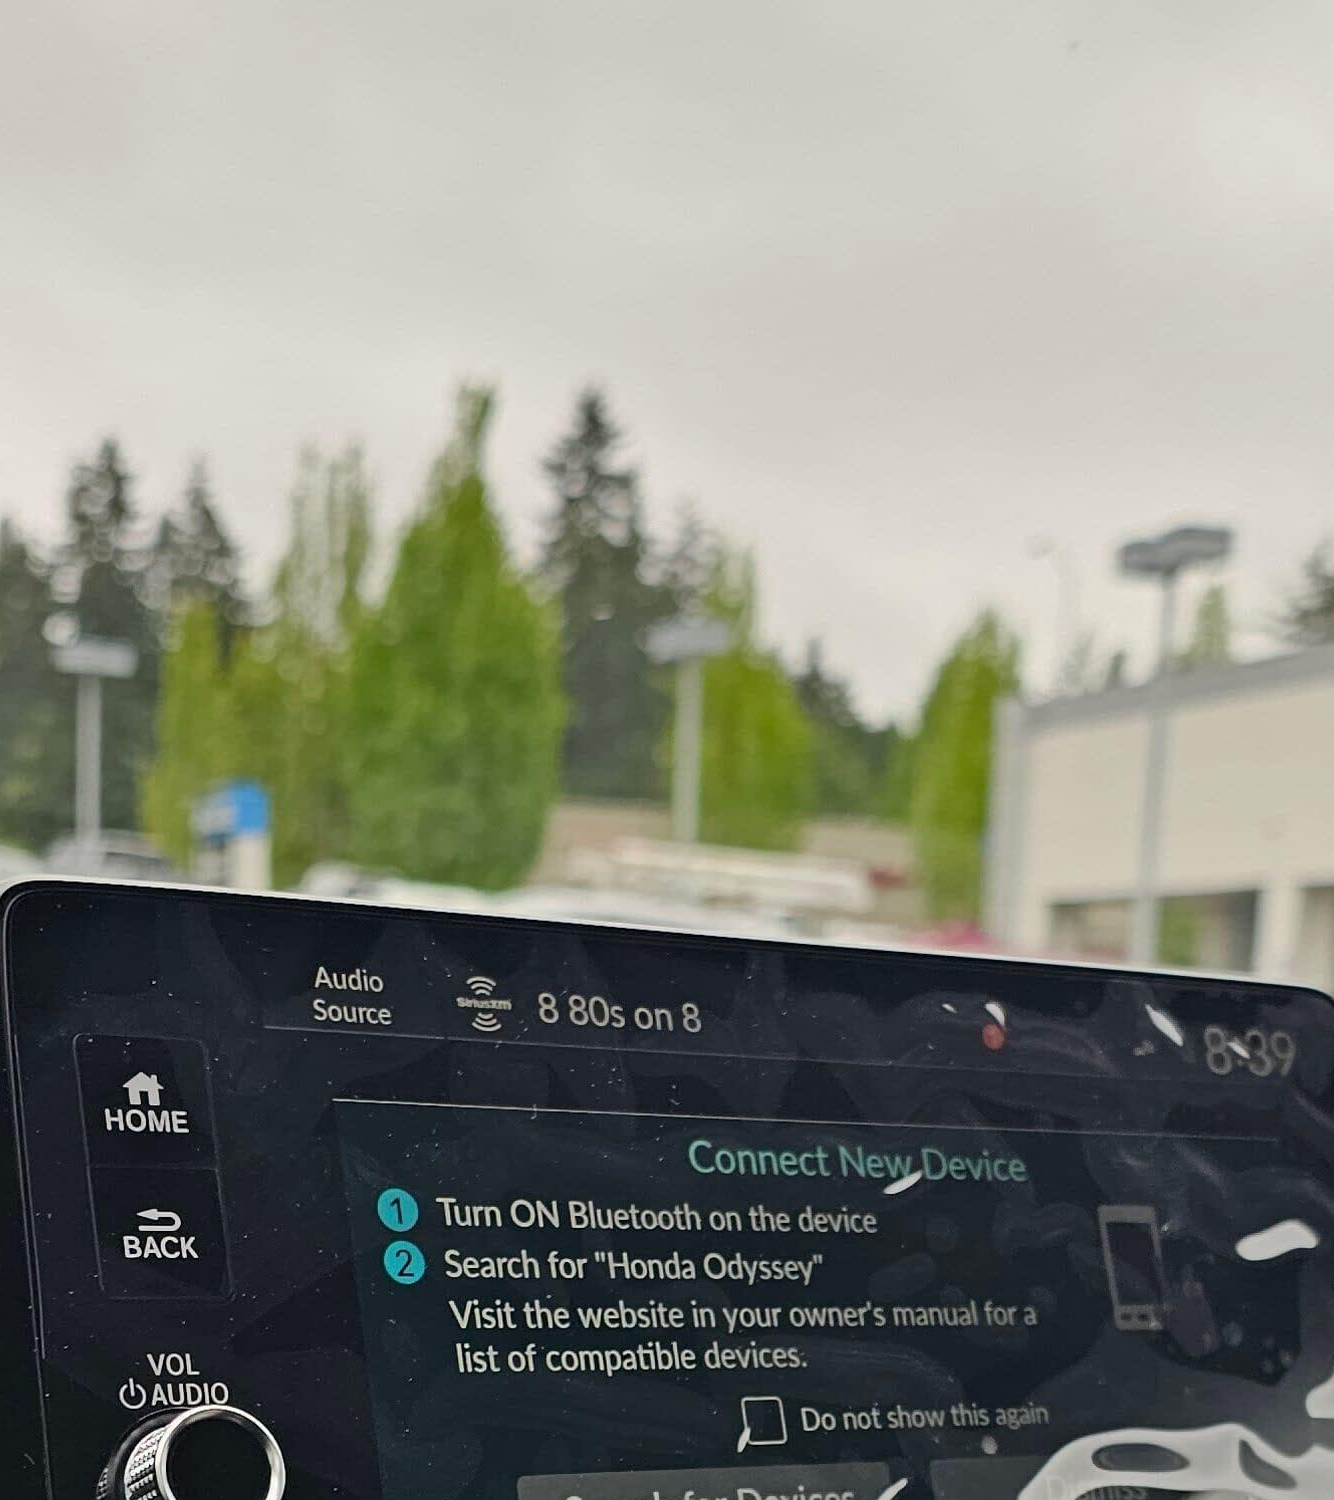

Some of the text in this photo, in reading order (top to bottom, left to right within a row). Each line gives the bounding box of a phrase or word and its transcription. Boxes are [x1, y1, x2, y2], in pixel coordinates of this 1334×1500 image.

[314, 966, 384, 993] Audio
[313, 998, 393, 1026] Source
[538, 992, 703, 1034] 8 80s on 8
[104, 1107, 190, 1134] HOME
[688, 1139, 1029, 1182] Connect New Device
[389, 1196, 878, 1233] 1 Turn ON Bluetooth on the device
[122, 1234, 199, 1260] BACK
[395, 1249, 823, 1286] 2 Search for "Honda Odyssey"
[449, 1299, 1038, 1334] Visit the website in your owner's manual for a
[146, 1352, 200, 1377] VOL
[455, 1341, 808, 1377] list of compatible devices.
[151, 1381, 229, 1407] AUDIO
[800, 1402, 1050, 1432] Do not show this again
